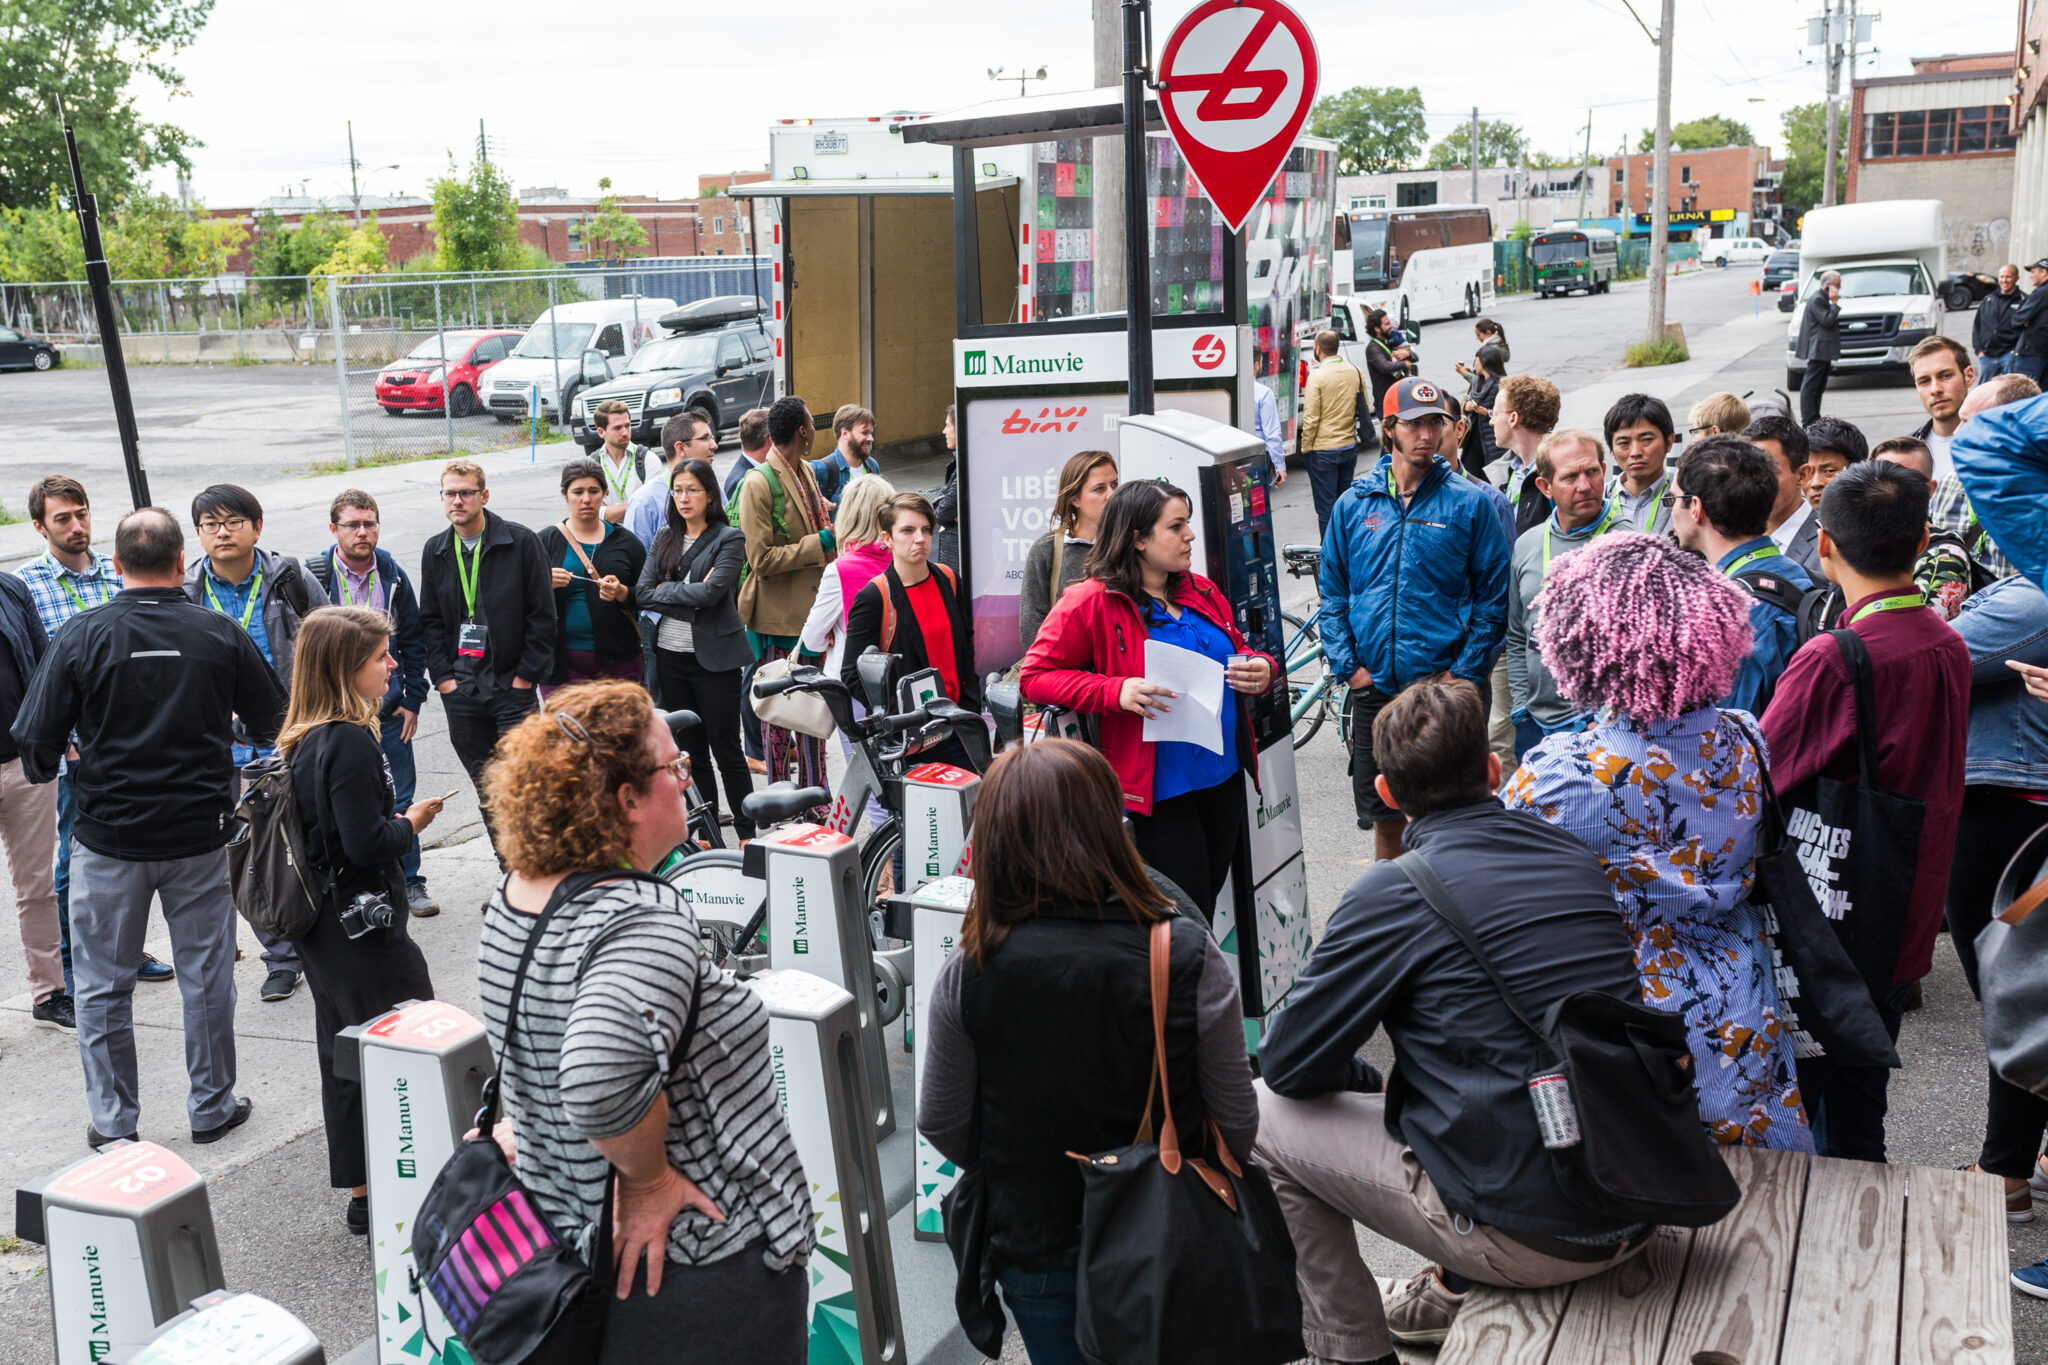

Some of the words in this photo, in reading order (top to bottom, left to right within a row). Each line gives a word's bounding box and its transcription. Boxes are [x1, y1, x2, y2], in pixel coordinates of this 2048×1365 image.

[992, 352, 1084, 375] Manuvie
[936, 771, 962, 782] 02
[1265, 793, 1292, 824] Manuvie
[803, 833, 835, 846] 02
[925, 806, 939, 860] Manuvie
[696, 892, 746, 905] Manuvie
[792, 876, 809, 936] Manuvie
[411, 1018, 457, 1038] 02
[393, 1077, 415, 1155] Manuvie
[109, 1165, 167, 1194] 02
[82, 1245, 110, 1335] Manuvie
